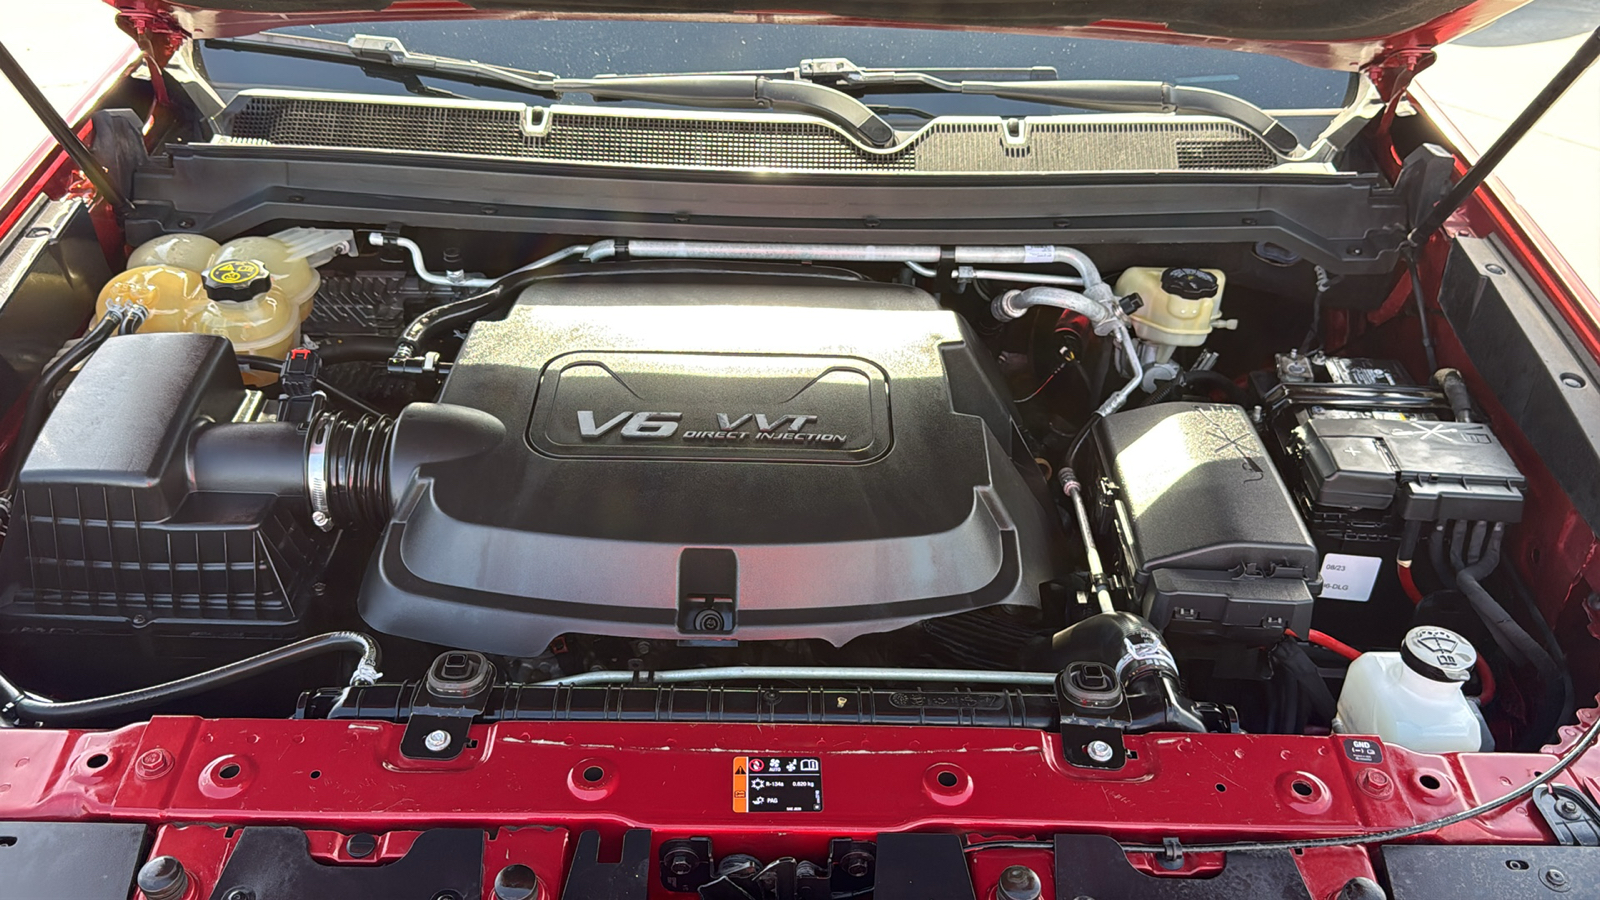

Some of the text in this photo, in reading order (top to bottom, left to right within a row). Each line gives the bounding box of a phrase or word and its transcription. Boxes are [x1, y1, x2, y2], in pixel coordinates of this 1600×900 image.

[576, 410, 818, 439] V6 VVT
[682, 430, 847, 444] DIRECT INJECTION
[1325, 564, 1346, 572] 08/23
[1352, 740, 1371, 749] GND
